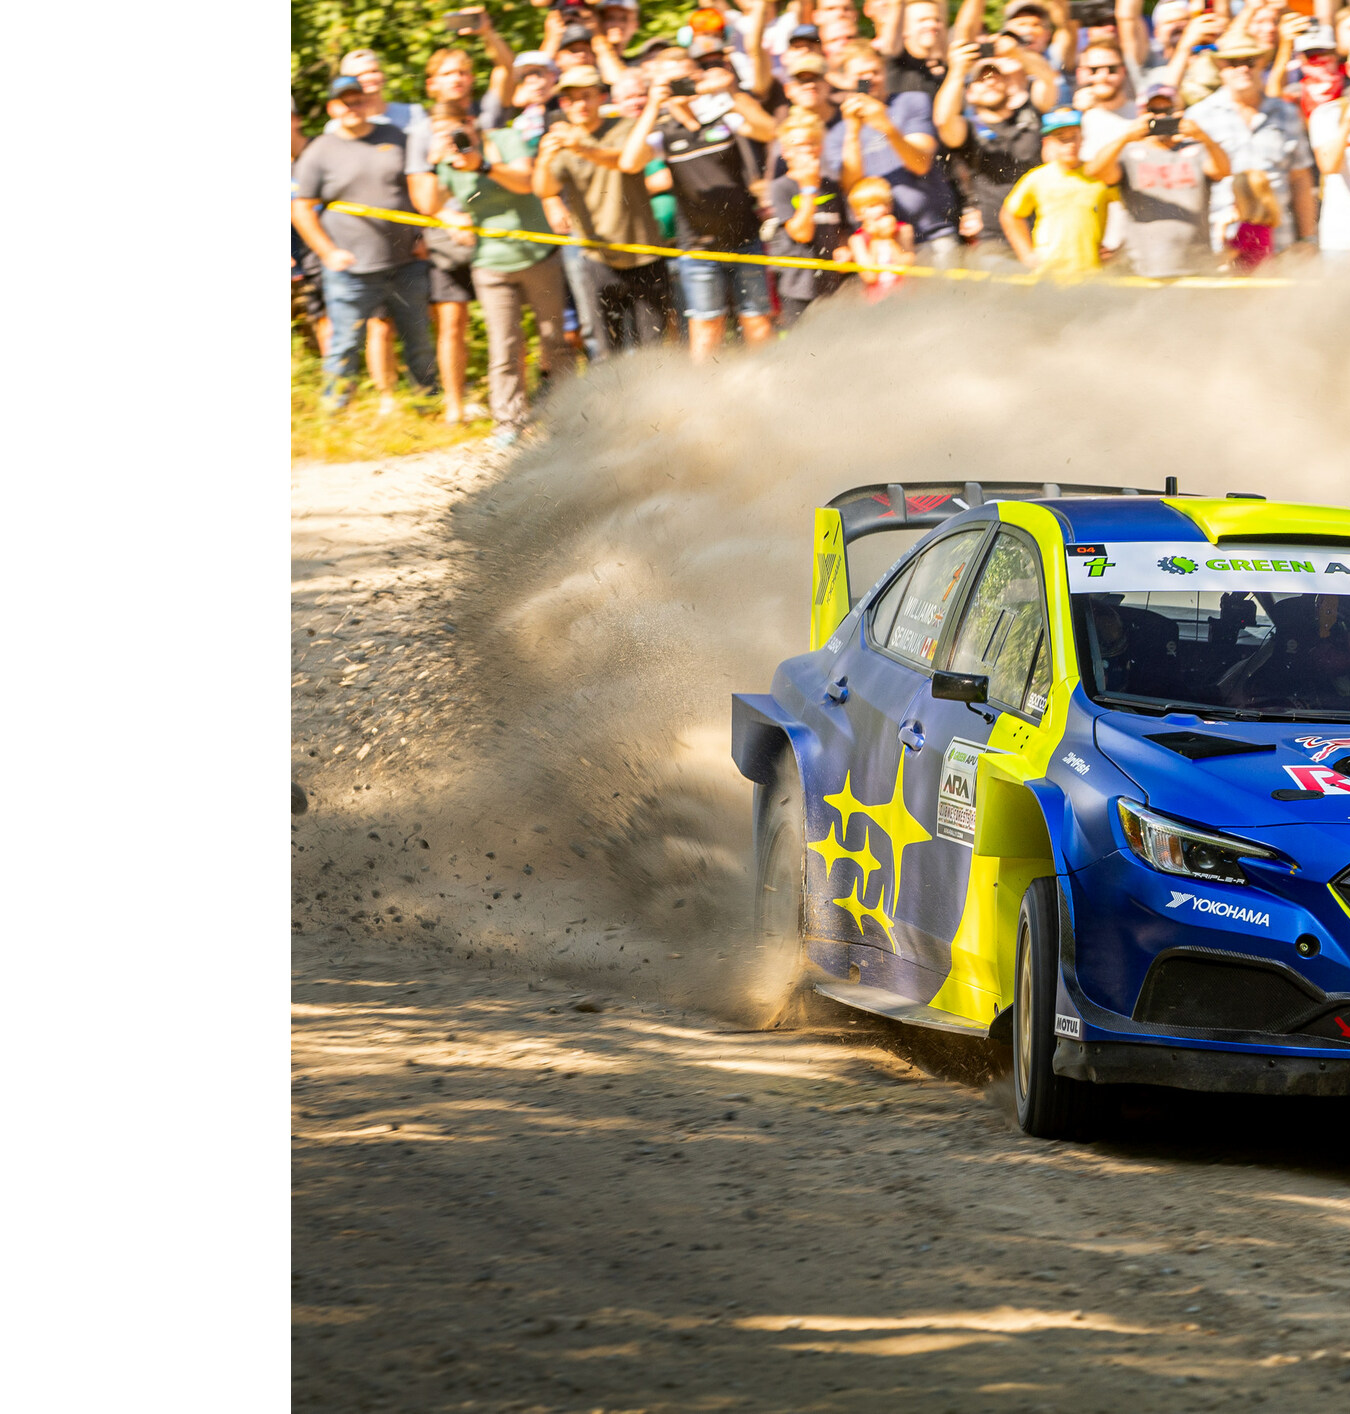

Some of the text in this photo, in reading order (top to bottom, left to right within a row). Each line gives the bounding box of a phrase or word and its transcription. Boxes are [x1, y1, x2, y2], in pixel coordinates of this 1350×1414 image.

[1076, 546, 1096, 554] 04
[1083, 556, 1116, 578] 1
[1205, 558, 1316, 574] GREEN
[943, 773, 970, 800] ARA
[1192, 872, 1246, 885] TRIPLE-R
[1192, 896, 1270, 928] YOKOHAMA
[1055, 1016, 1079, 1034] MOTUL
